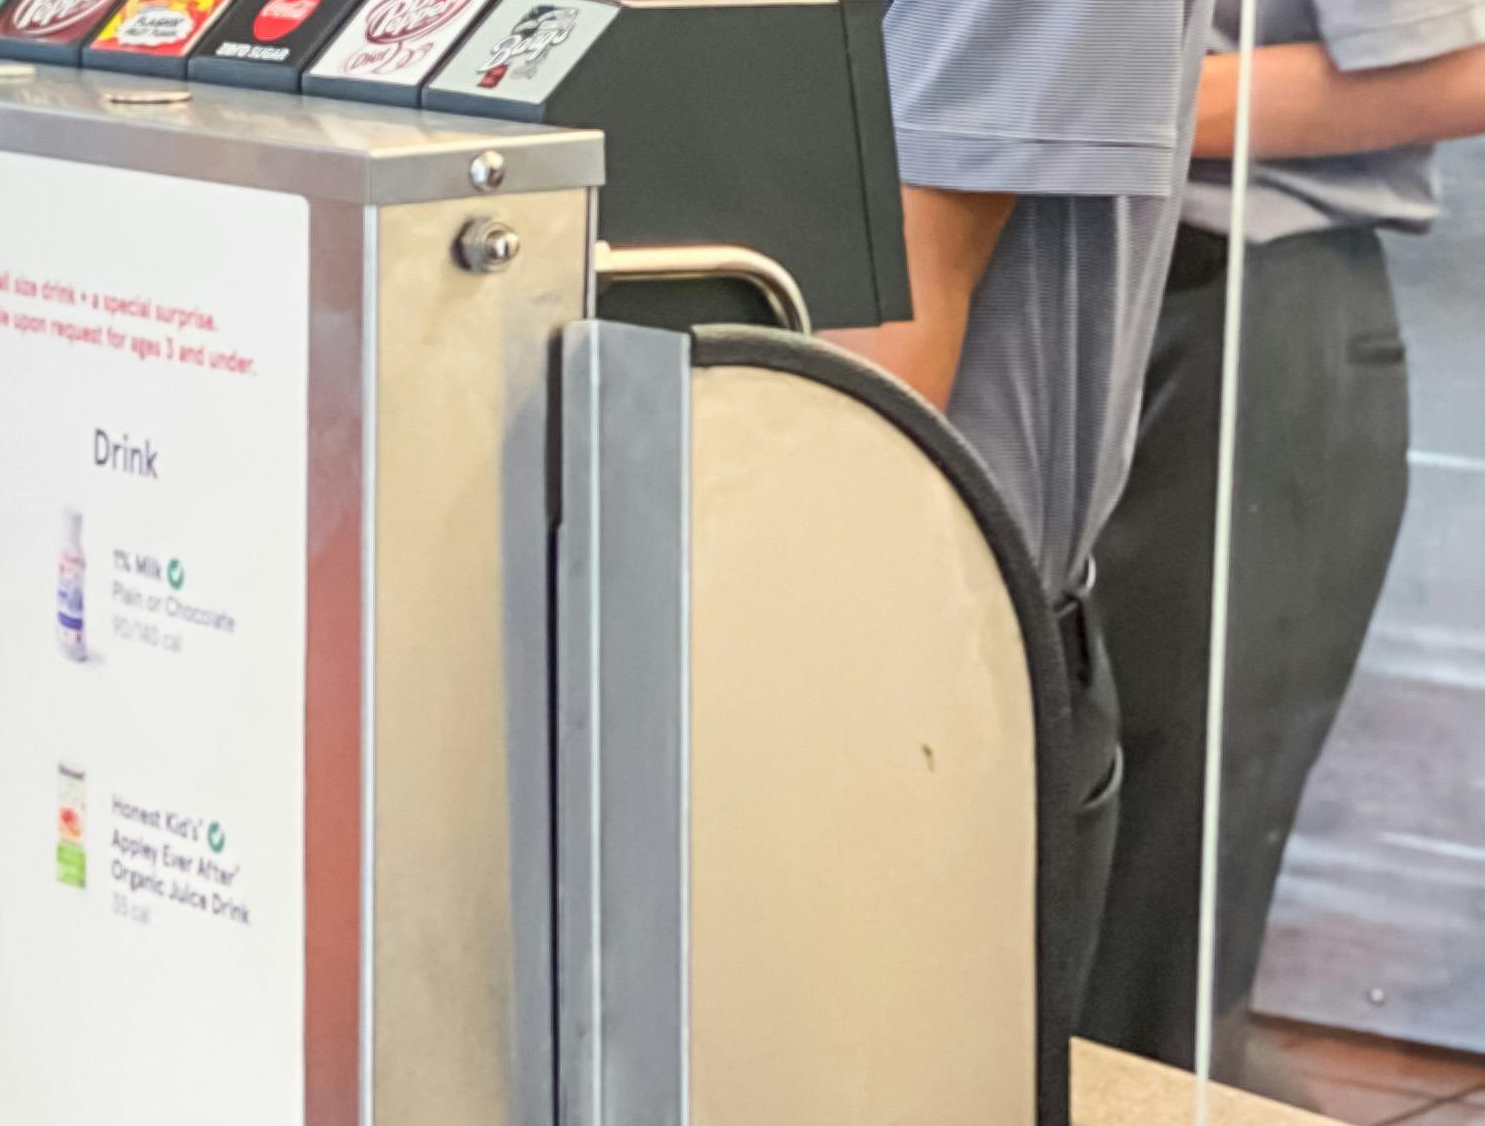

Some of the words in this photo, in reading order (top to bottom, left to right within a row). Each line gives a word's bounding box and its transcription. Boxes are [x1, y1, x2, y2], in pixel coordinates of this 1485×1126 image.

[247, 44, 291, 61] SUGAR
[41, 281, 75, 305] drink
[104, 294, 151, 319] special
[14, 314, 46, 334] upon
[51, 322, 102, 345] request
[107, 326, 126, 349] for
[131, 337, 160, 360] ages
[179, 344, 204, 366] and
[94, 428, 158, 479] Drink
[135, 554, 162, 580] Milk
[113, 579, 143, 605] Plain
[147, 595, 162, 612] or
[166, 595, 236, 634] Chocolate
[112, 795, 162, 828] Honest
[112, 828, 158, 862] Appley
[163, 843, 193, 873] Ever
[112, 858, 165, 896] Organic
[169, 881, 207, 910] Juice
[212, 892, 251, 924] Drink
